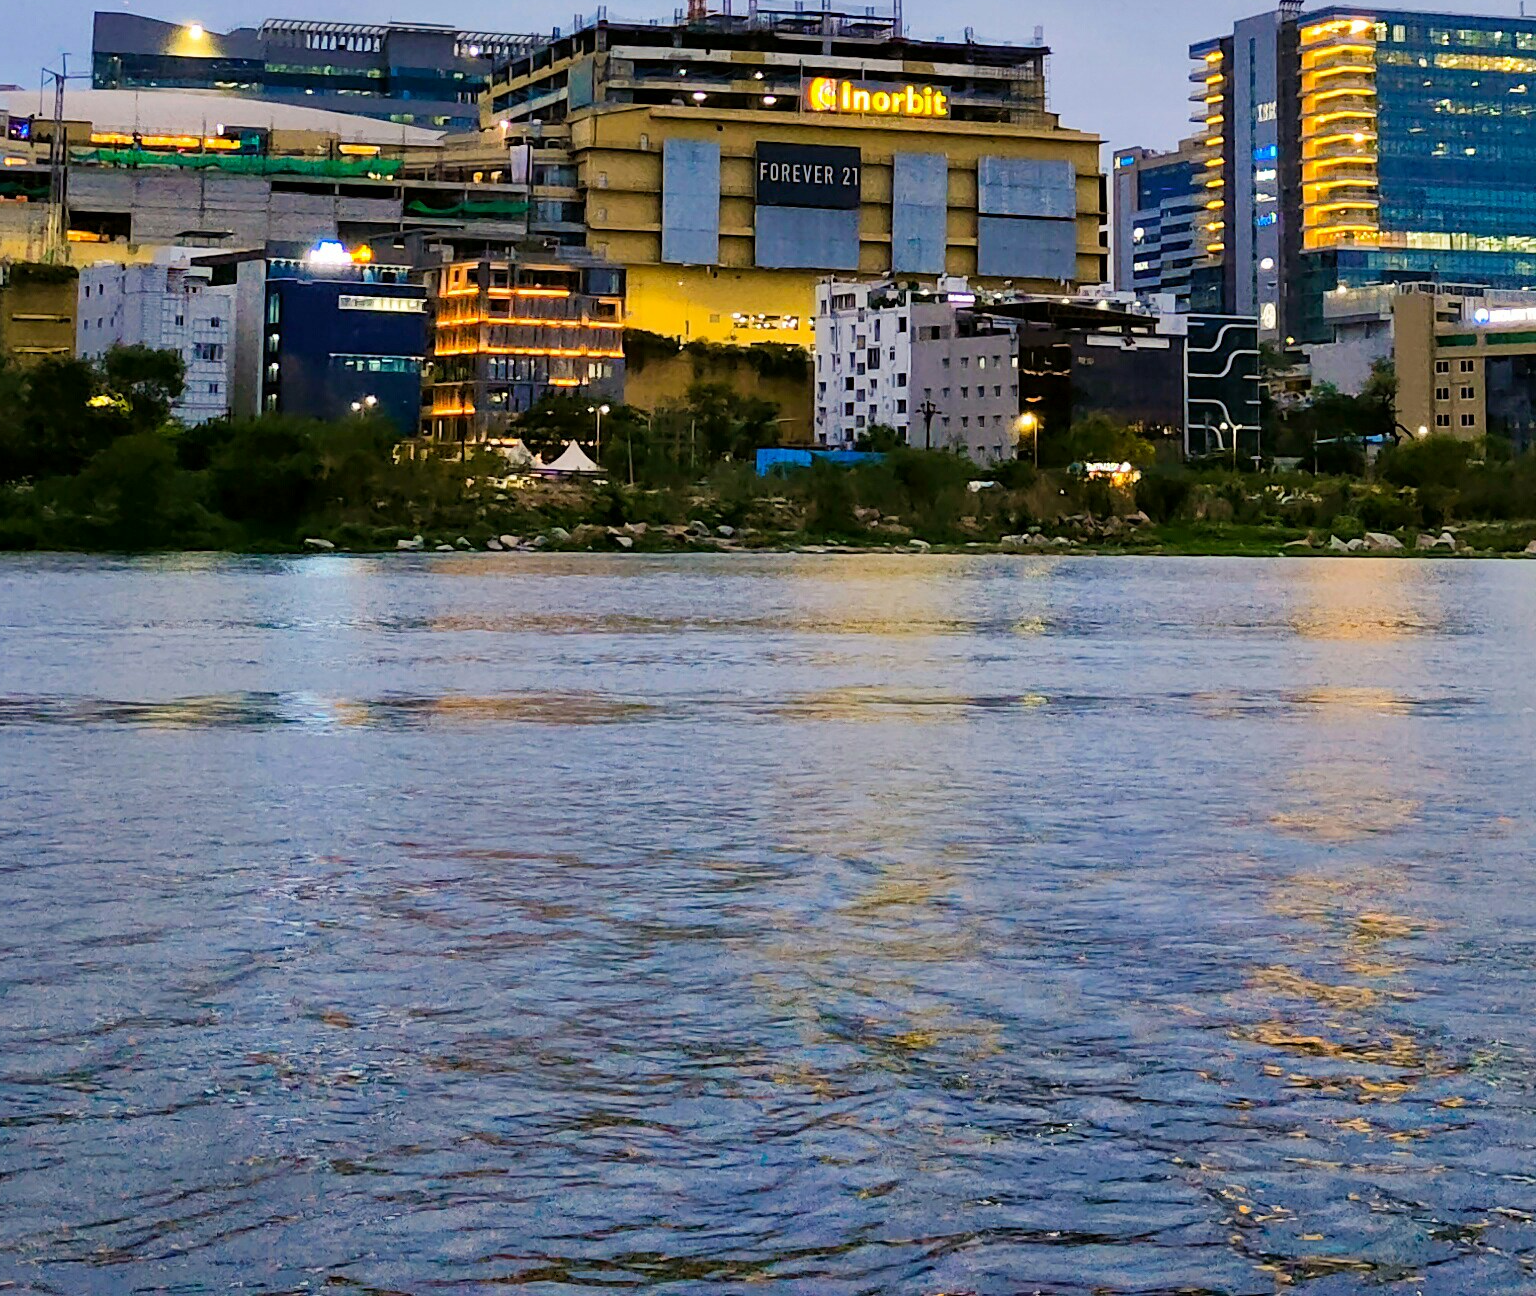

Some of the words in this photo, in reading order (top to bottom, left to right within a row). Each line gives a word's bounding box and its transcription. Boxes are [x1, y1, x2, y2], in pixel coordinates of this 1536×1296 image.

[840, 80, 949, 116] Inorbit
[759, 162, 834, 185] FOREVER
[842, 166, 859, 186] 21
